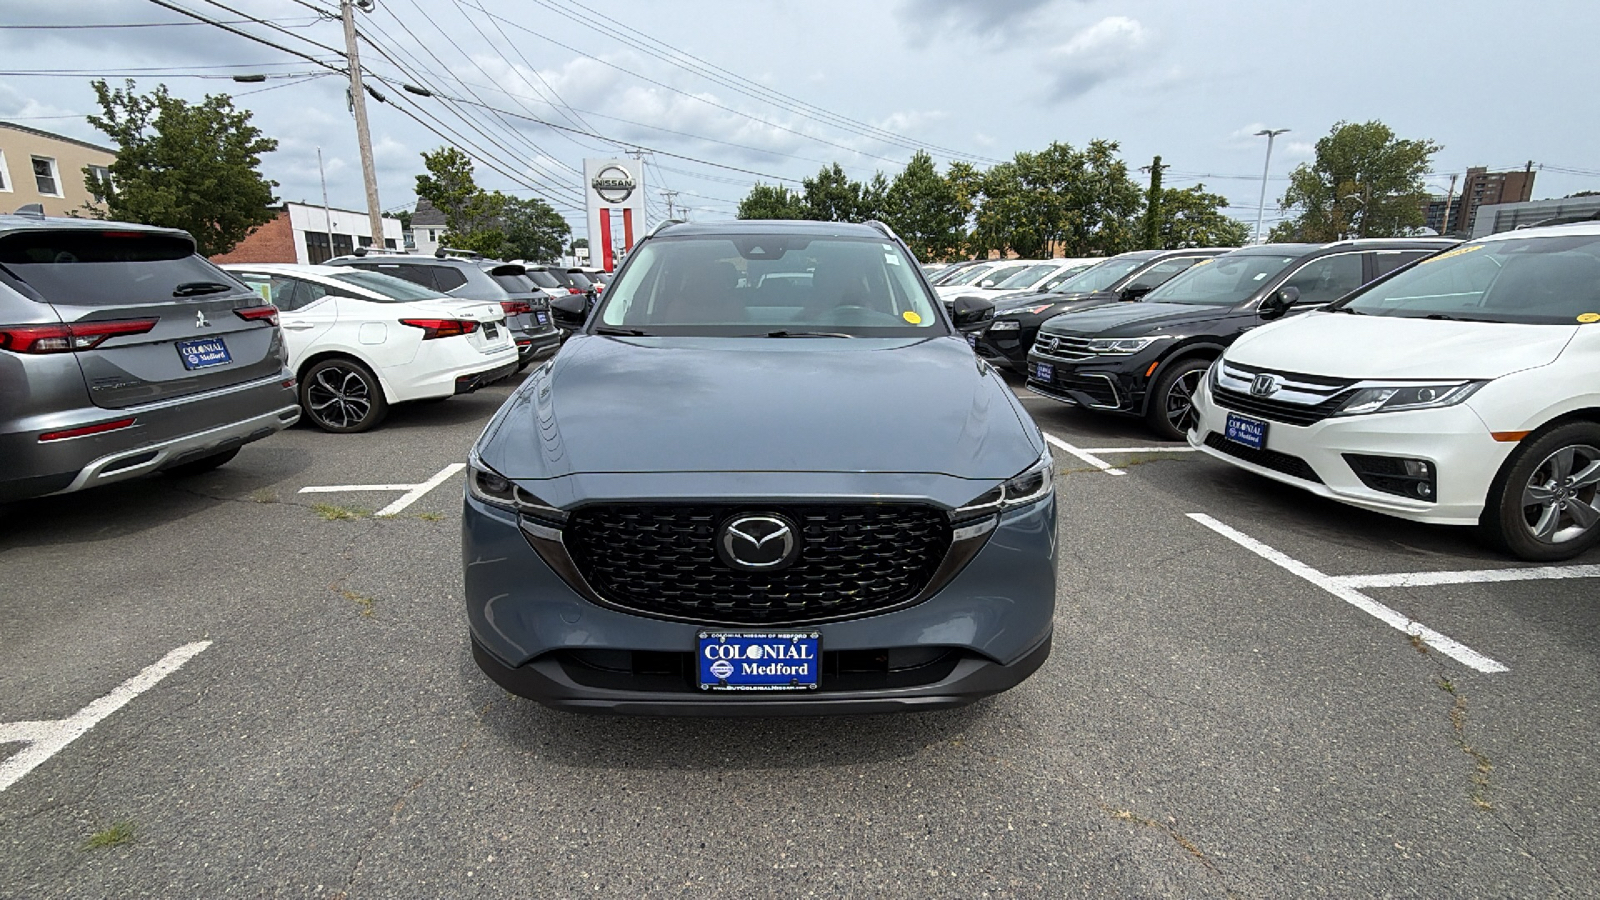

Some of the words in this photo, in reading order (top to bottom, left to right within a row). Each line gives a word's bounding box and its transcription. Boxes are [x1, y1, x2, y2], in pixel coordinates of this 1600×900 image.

[596, 179, 632, 187] NISSAN
[183, 343, 224, 355] COLONIAL
[705, 644, 814, 660] COLONIAL
[741, 662, 808, 675] Medford
